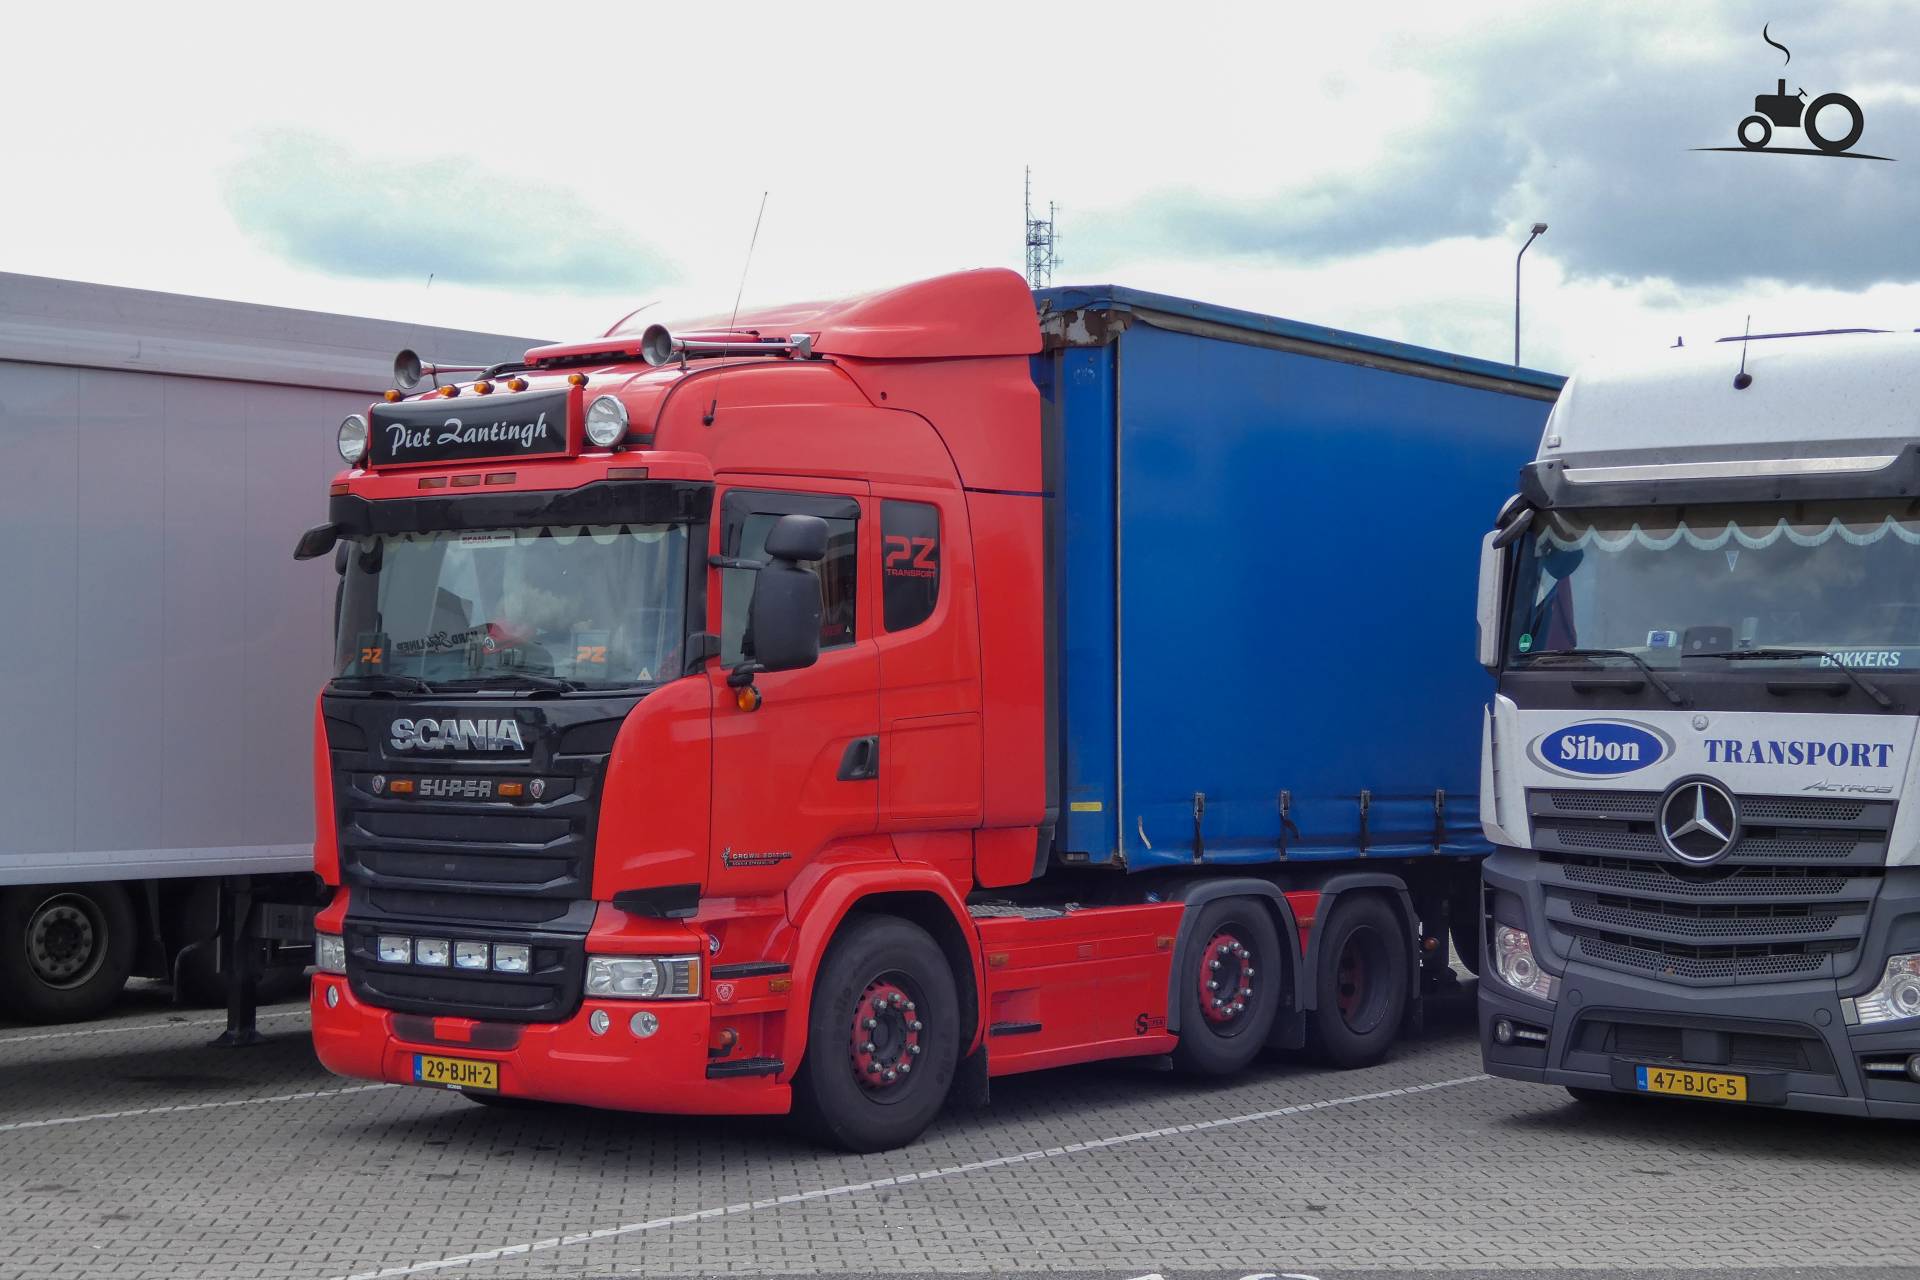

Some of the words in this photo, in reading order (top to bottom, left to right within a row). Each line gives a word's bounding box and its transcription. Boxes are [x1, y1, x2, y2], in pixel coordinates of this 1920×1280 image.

[386, 423, 431, 456] Piet
[437, 412, 547, 448] Zantingh
[885, 535, 936, 569] PZ
[886, 568, 936, 579] TRANSPORT
[1820, 651, 1901, 667] BOKKERS
[390, 718, 525, 751] SCANIA
[1560, 734, 1640, 762] Sibon
[1704, 739, 1894, 768] TRANSPORT
[419, 778, 493, 799] SUPER
[427, 1060, 492, 1085] 29-BJH-2
[1653, 1071, 1738, 1096] 47-BJG-5
